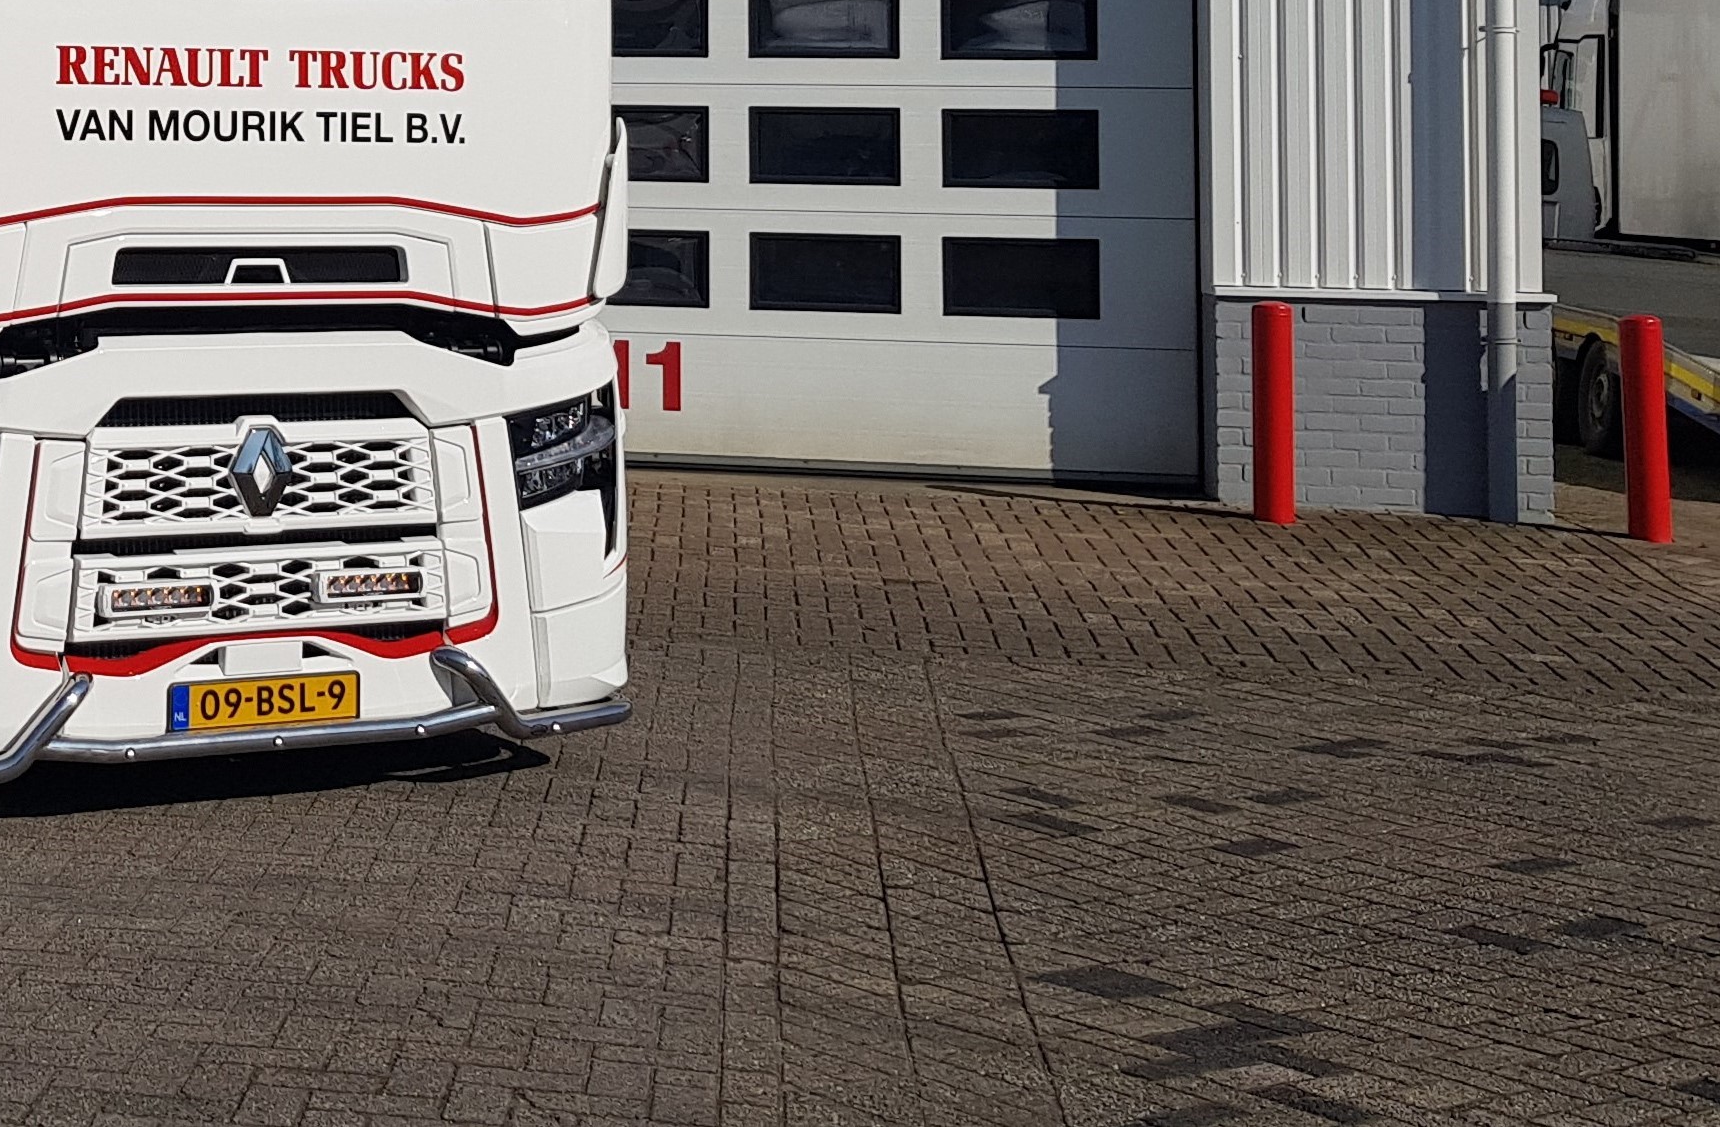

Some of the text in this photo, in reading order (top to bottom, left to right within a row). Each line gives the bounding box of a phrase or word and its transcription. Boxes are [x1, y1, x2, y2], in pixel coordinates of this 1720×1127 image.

[55, 45, 466, 92] RENAULT TRUCKS
[55, 108, 467, 145] VAN MOURIK TIEL B.V.
[173, 712, 188, 723] NL
[199, 678, 347, 722] 09-BSL-9
